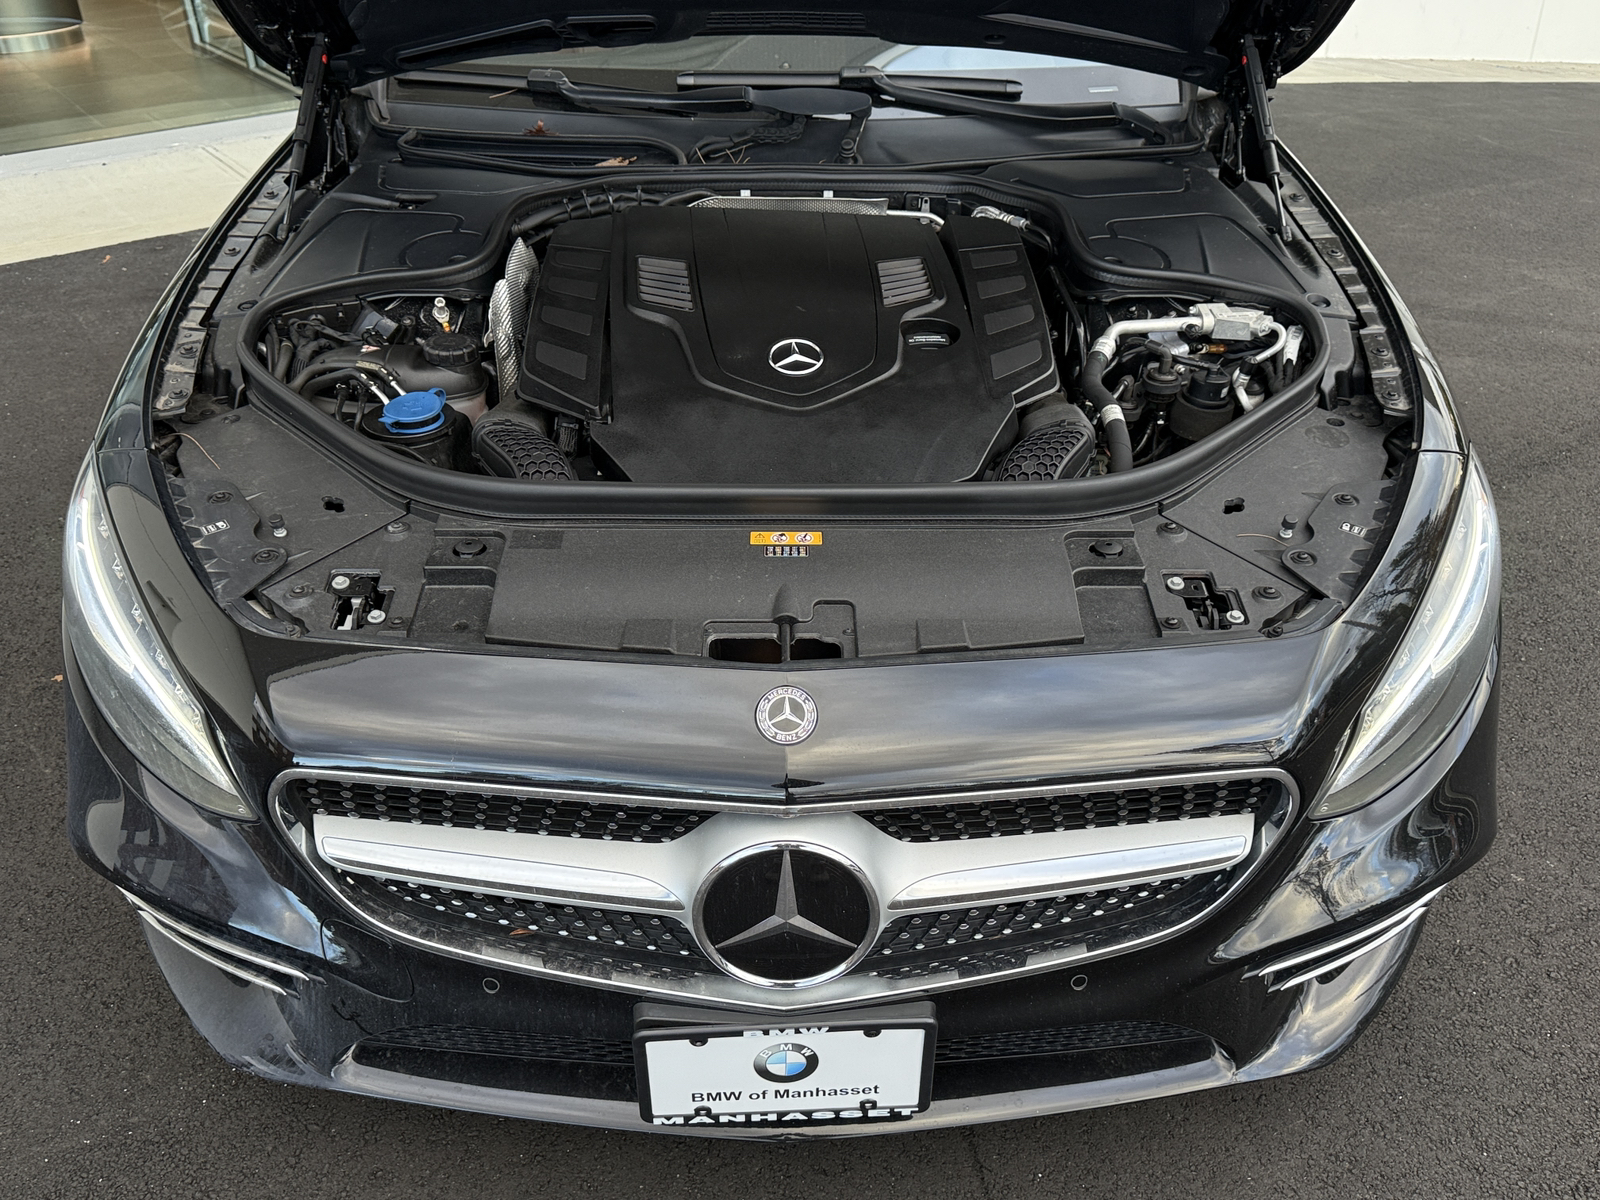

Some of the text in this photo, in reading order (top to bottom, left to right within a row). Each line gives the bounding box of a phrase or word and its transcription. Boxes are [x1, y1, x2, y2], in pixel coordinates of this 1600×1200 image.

[767, 688, 807, 700] MERCEDES
[776, 733, 798, 742] BENZ
[743, 1026, 829, 1038] BMW
[760, 1043, 814, 1058] BMW
[691, 1084, 880, 1102] BMW of Manhasset
[653, 1107, 919, 1125] MANHASSET
